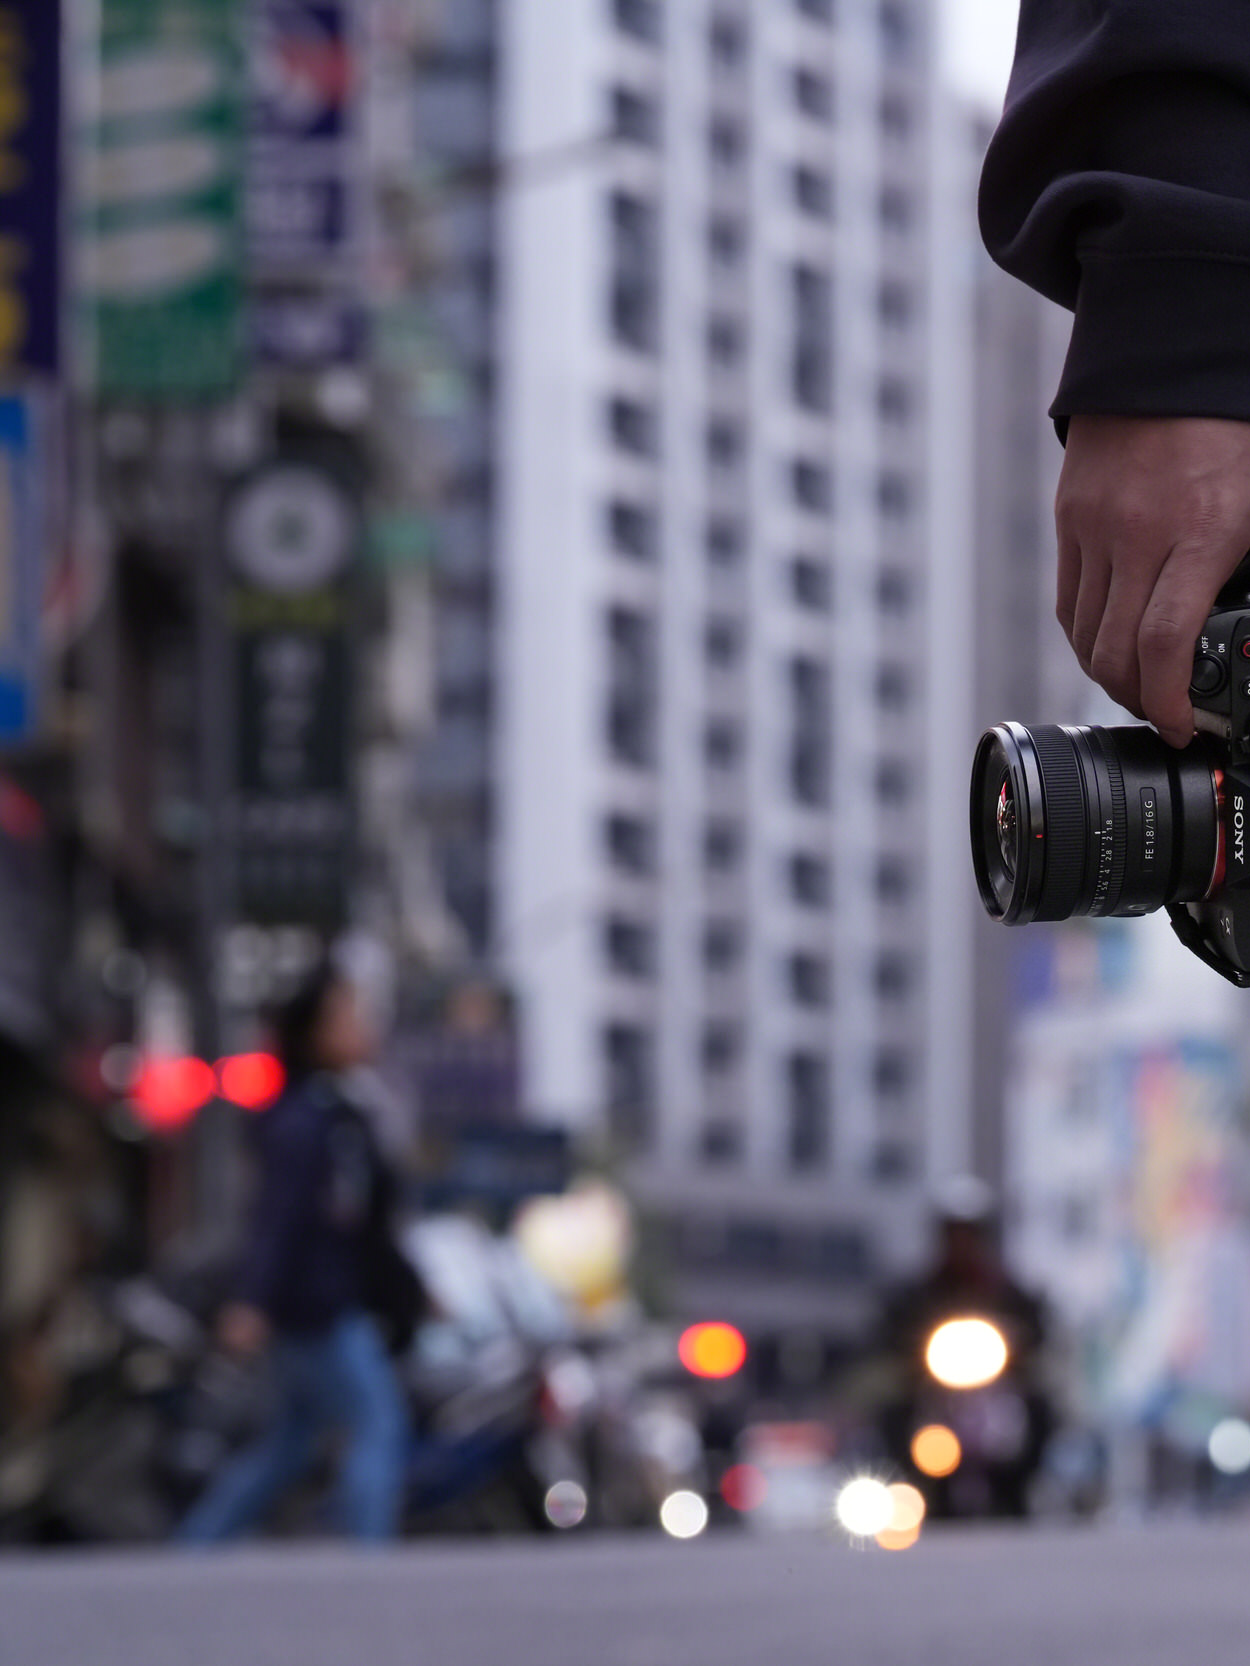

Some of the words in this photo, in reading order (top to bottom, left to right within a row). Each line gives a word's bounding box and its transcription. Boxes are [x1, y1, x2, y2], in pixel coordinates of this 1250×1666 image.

[1201, 636, 1209, 649] OFF
[1218, 643, 1226, 653] ON
[1144, 800, 1154, 809] G
[1105, 819, 1113, 831] 1.8
[1145, 810, 1155, 846] 1.8/16
[1233, 795, 1244, 865] SONY
[1105, 849, 1113, 861] 2.8
[1144, 848, 1155, 860] FE
